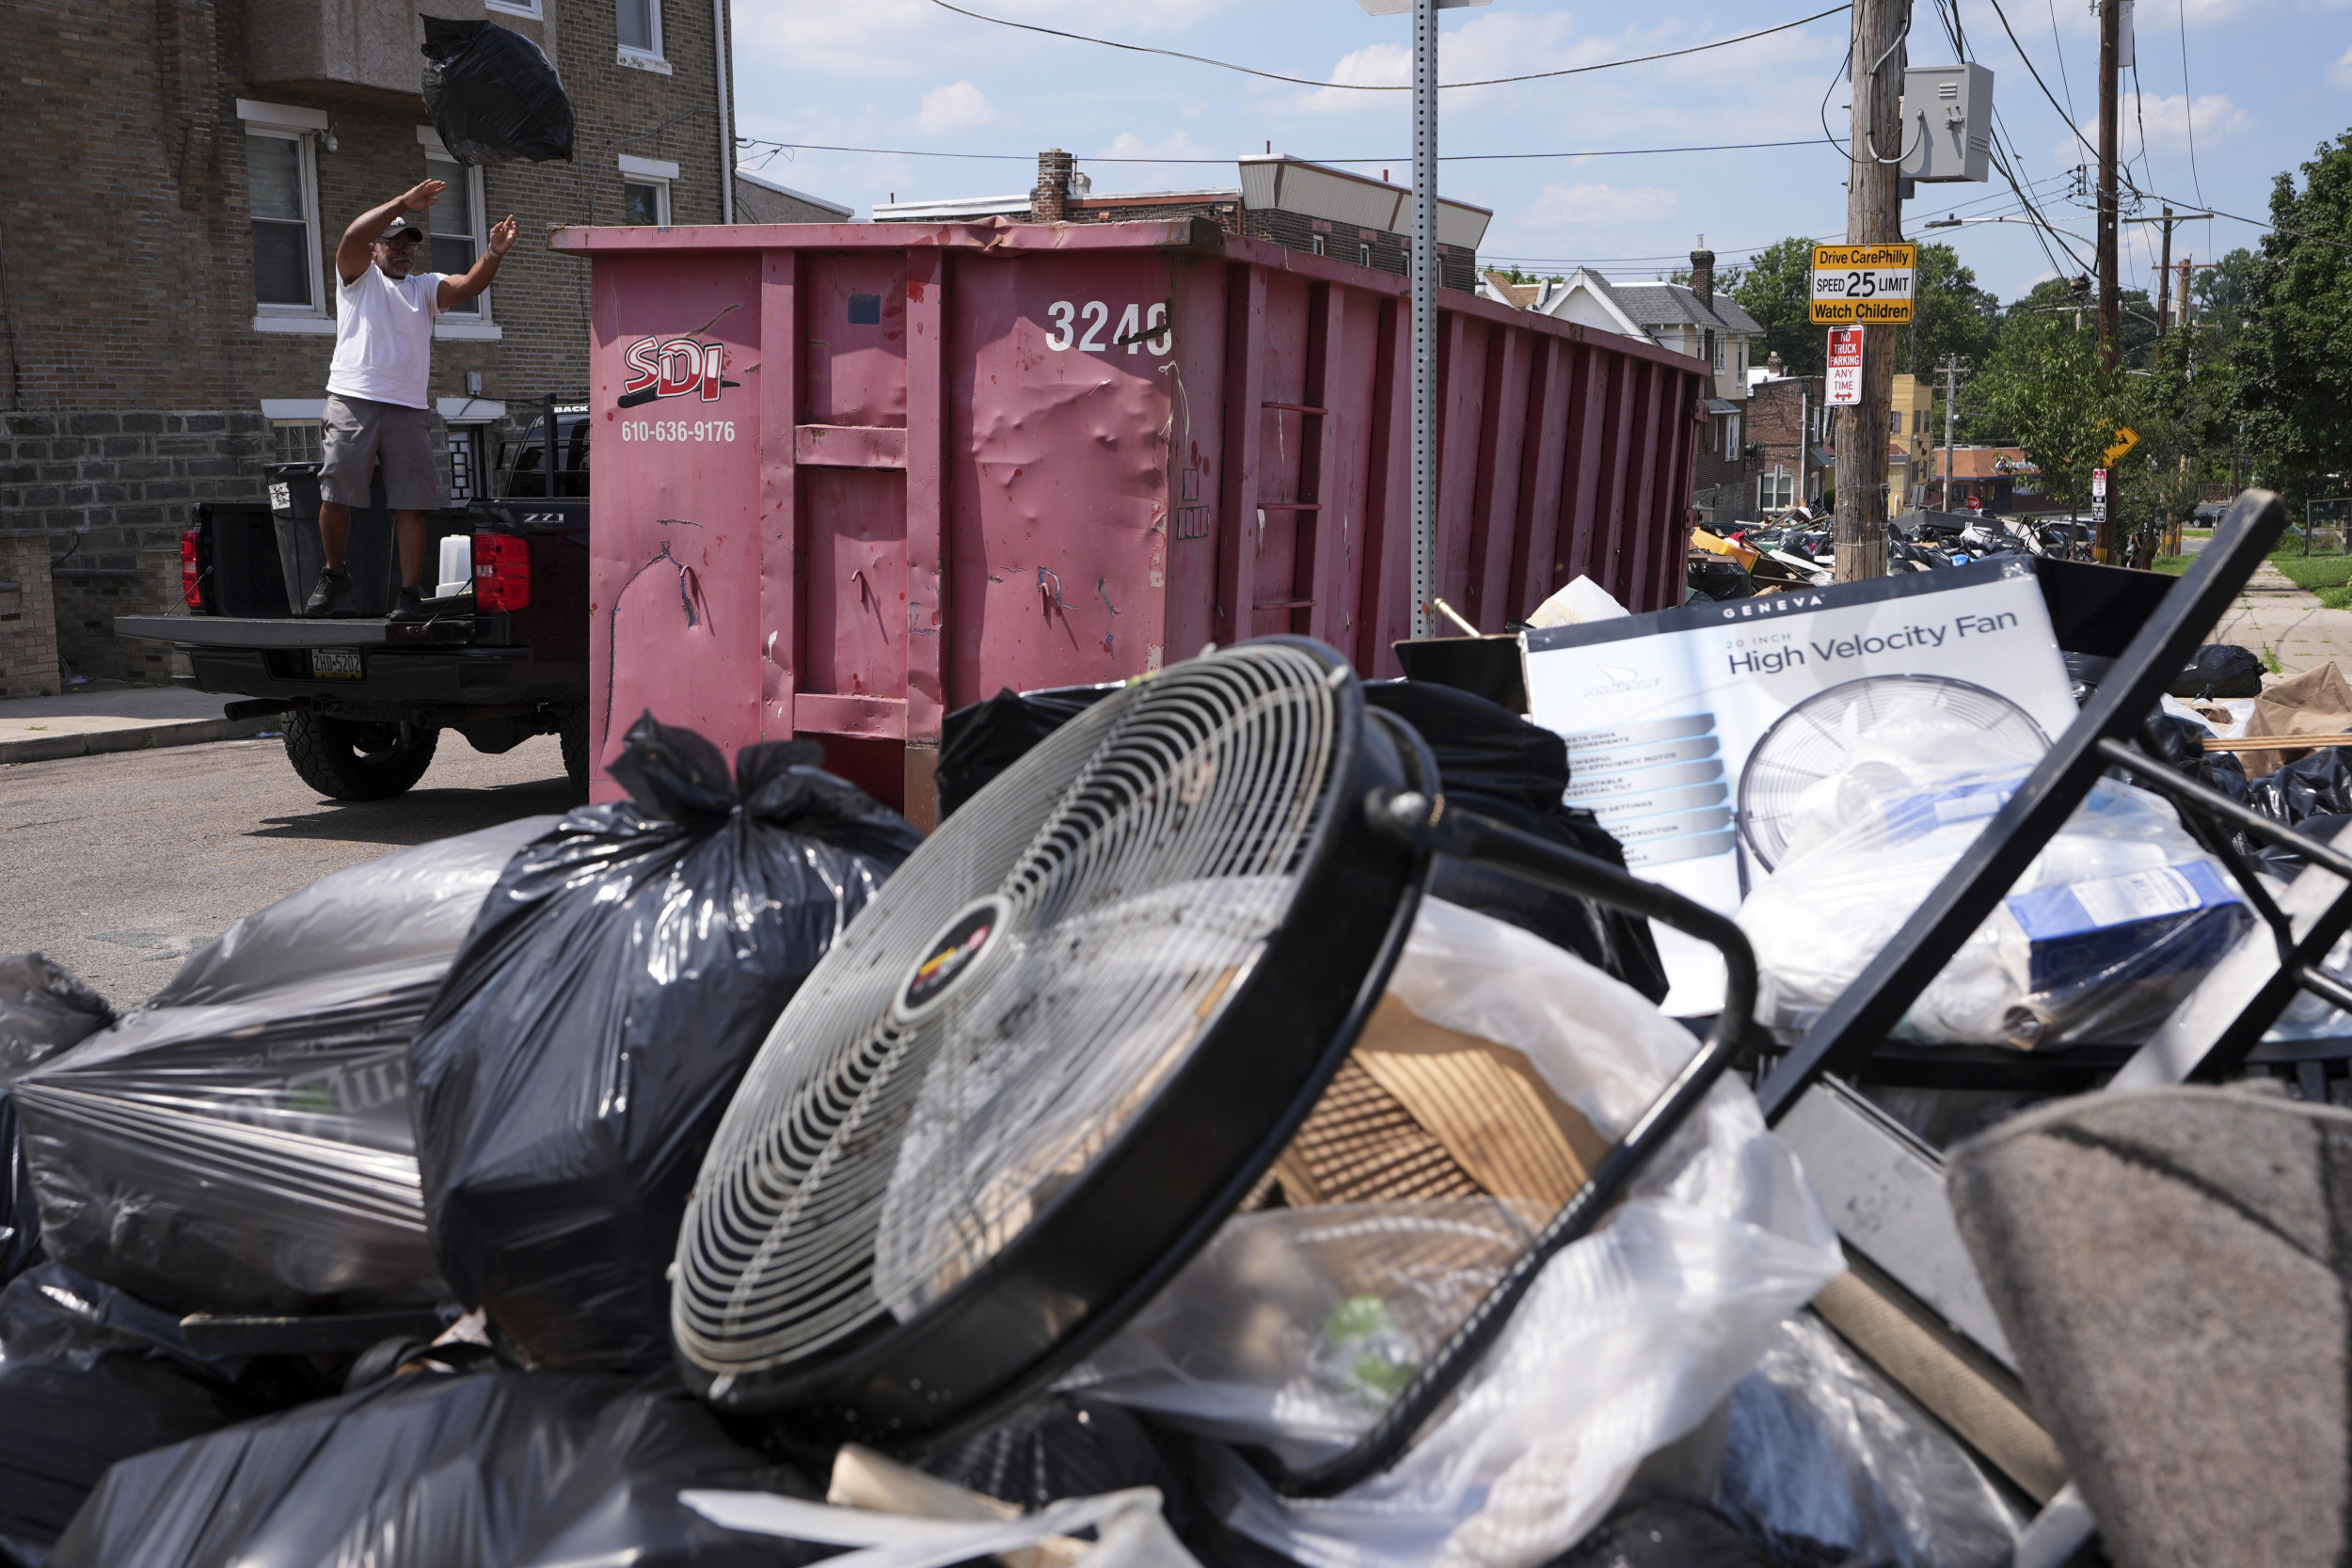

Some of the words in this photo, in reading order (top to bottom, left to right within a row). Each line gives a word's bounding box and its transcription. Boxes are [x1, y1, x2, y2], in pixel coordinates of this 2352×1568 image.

[1820, 250, 1848, 264] Drive
[1851, 249, 1909, 265] CarePhilly
[1817, 278, 1845, 293] SPEED
[1846, 271, 1876, 297] 25
[1878, 277, 1909, 292] LIMIT
[1815, 304, 1852, 319] Watch
[1855, 303, 1909, 319] Children
[1840, 332, 1851, 342] NO
[1834, 343, 1857, 355] TRUCK
[1830, 355, 1860, 366] PARKING
[624, 335, 723, 403] SDI
[1834, 369, 1854, 378] ANY
[1835, 381, 1854, 390] TIME
[553, 404, 589, 413] BACK
[622, 420, 736, 442] 610-636-9176
[523, 513, 564, 523] Z71
[1723, 595, 1823, 619] GENEVA
[1726, 639, 1744, 649] 20
[1752, 632, 1792, 645] INCH
[1728, 646, 1805, 674] High
[1810, 625, 1947, 660] Velocity
[1955, 611, 2019, 639] Fan
[1566, 735, 1588, 743] EETS
[1567, 755, 1612, 766] OWERFUL
[1645, 752, 1677, 762] MOTOR
[1610, 800, 1653, 812] SETTINGS
